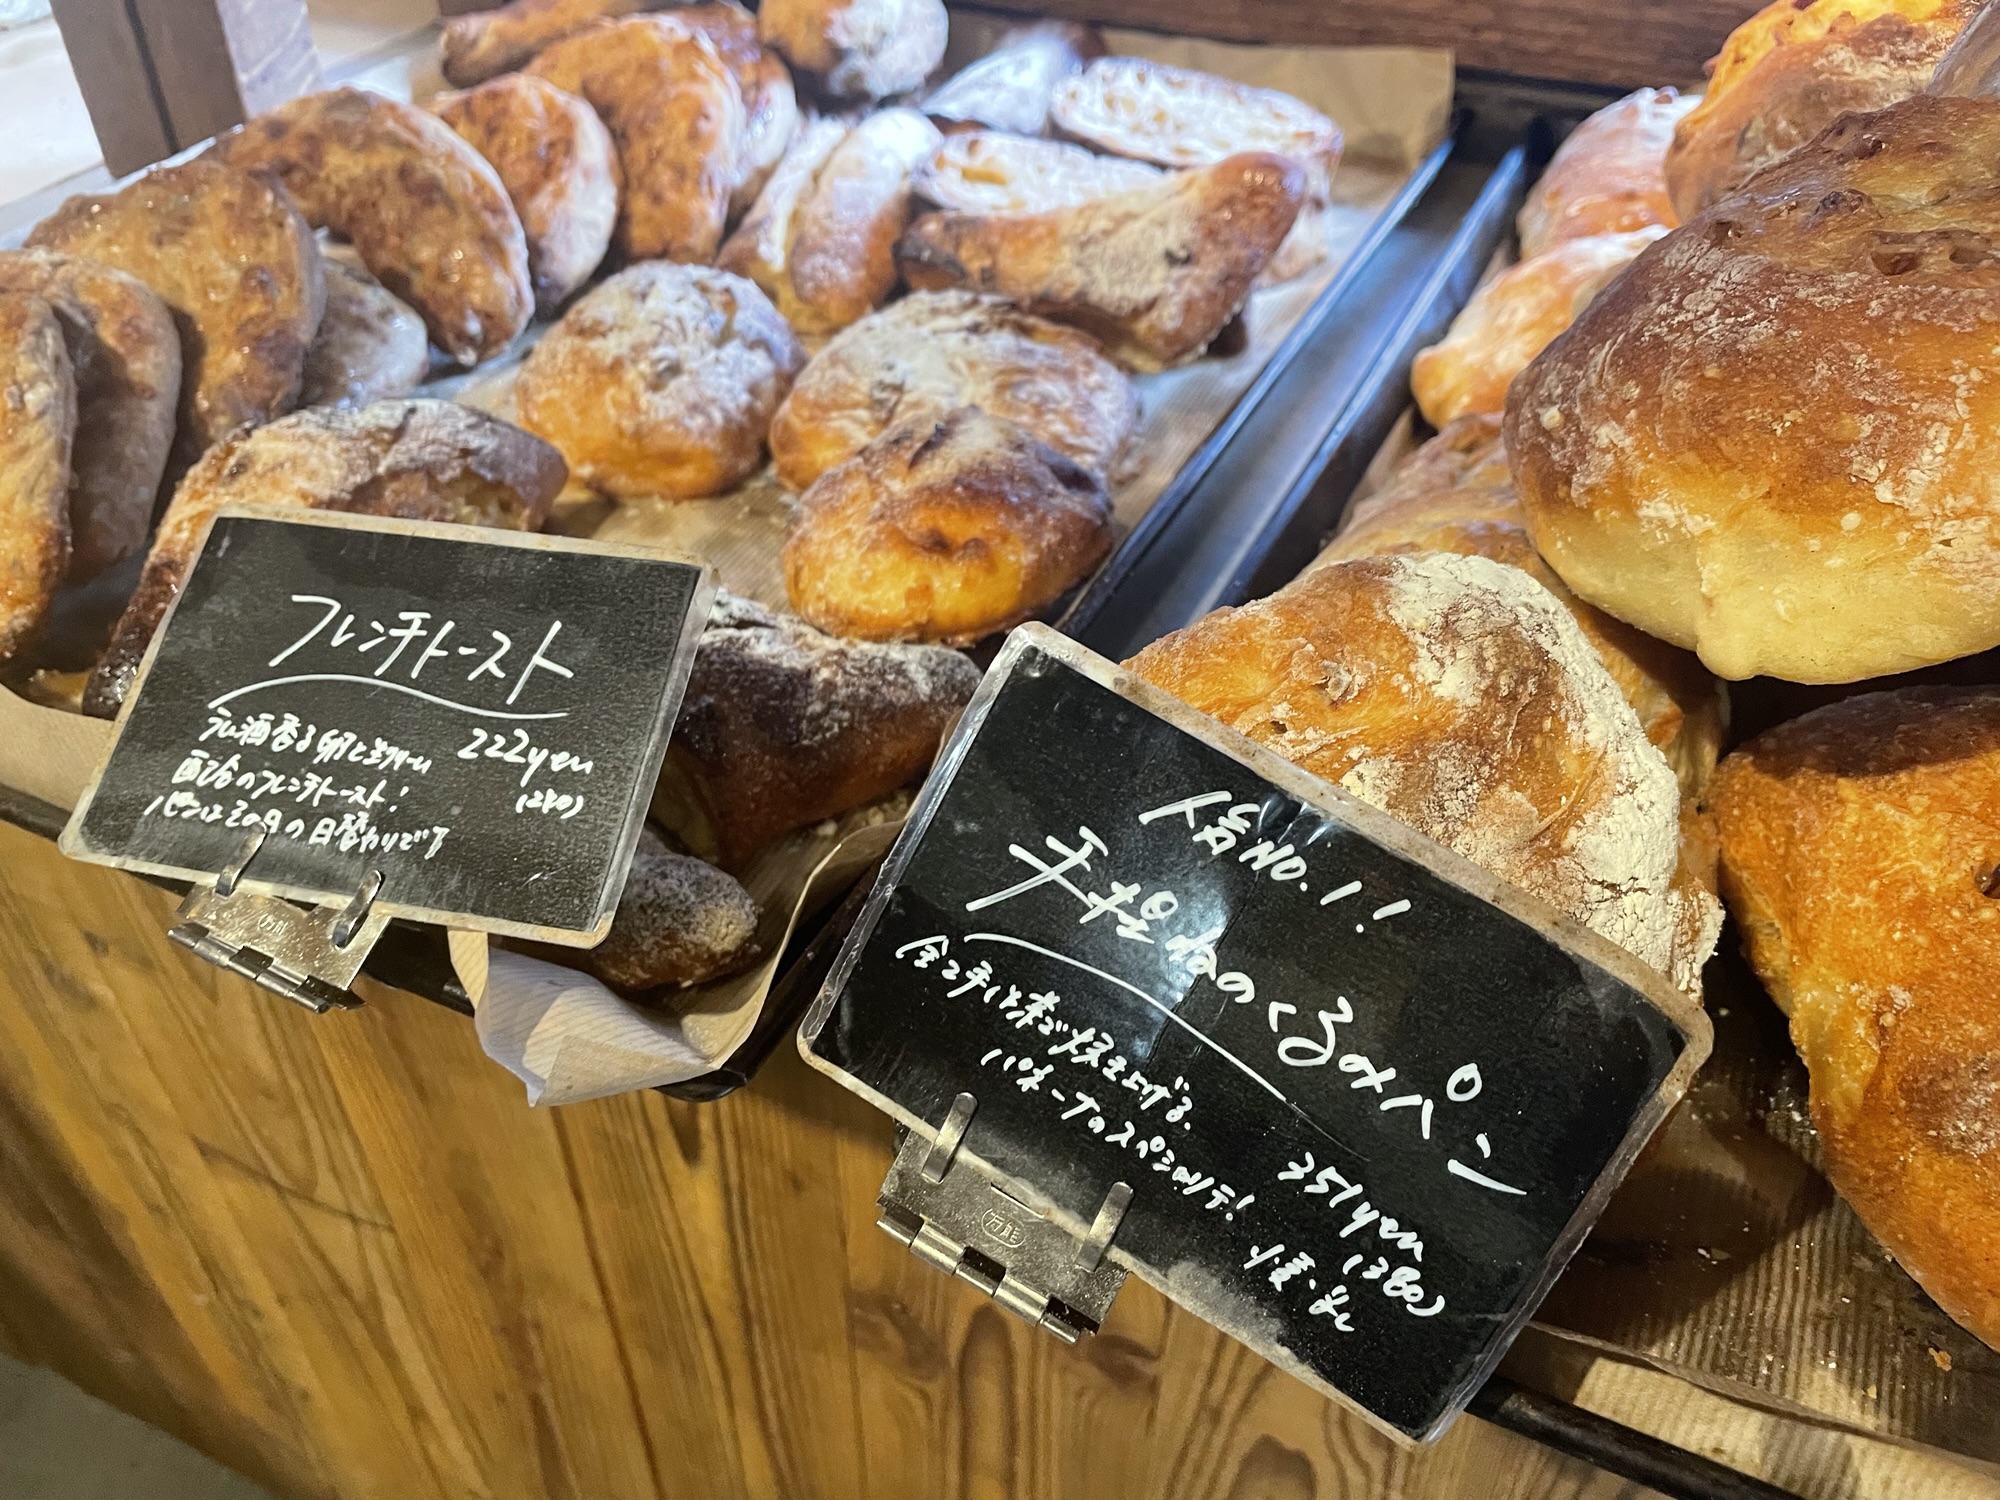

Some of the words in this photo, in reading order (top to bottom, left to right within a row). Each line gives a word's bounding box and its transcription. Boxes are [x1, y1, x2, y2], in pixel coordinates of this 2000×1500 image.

[269, 594, 575, 706] フレンチトースト
[456, 727, 596, 787] 222yen
[965, 826, 1528, 1196] 手捏ねのくるみパン
[1279, 1151, 1425, 1262] 351yen
[1343, 1254, 1446, 1319] (380)
